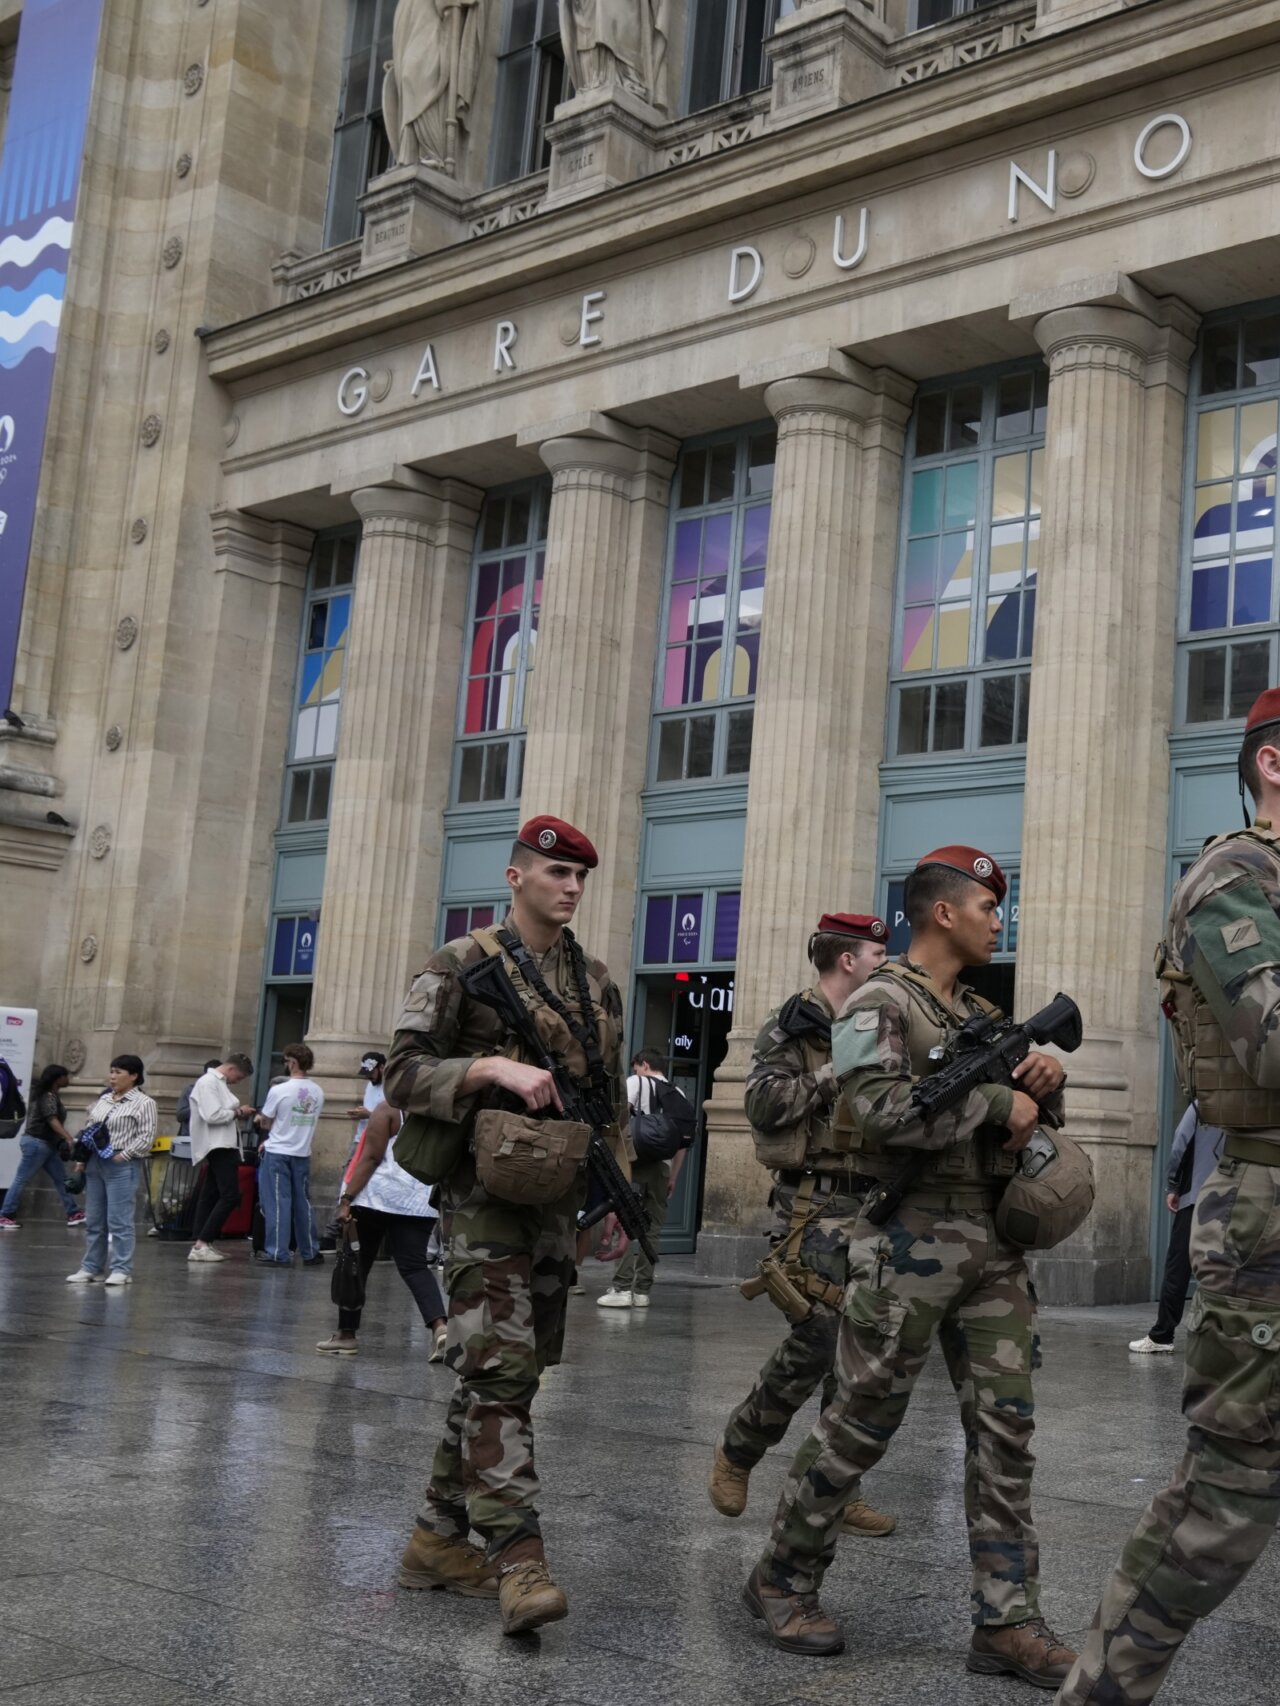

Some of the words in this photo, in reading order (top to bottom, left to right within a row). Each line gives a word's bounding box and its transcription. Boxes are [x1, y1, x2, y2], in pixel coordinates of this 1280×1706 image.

[337, 291, 607, 416] GARE
[728, 207, 871, 304] DU
[668, 1035, 693, 1050] aily
